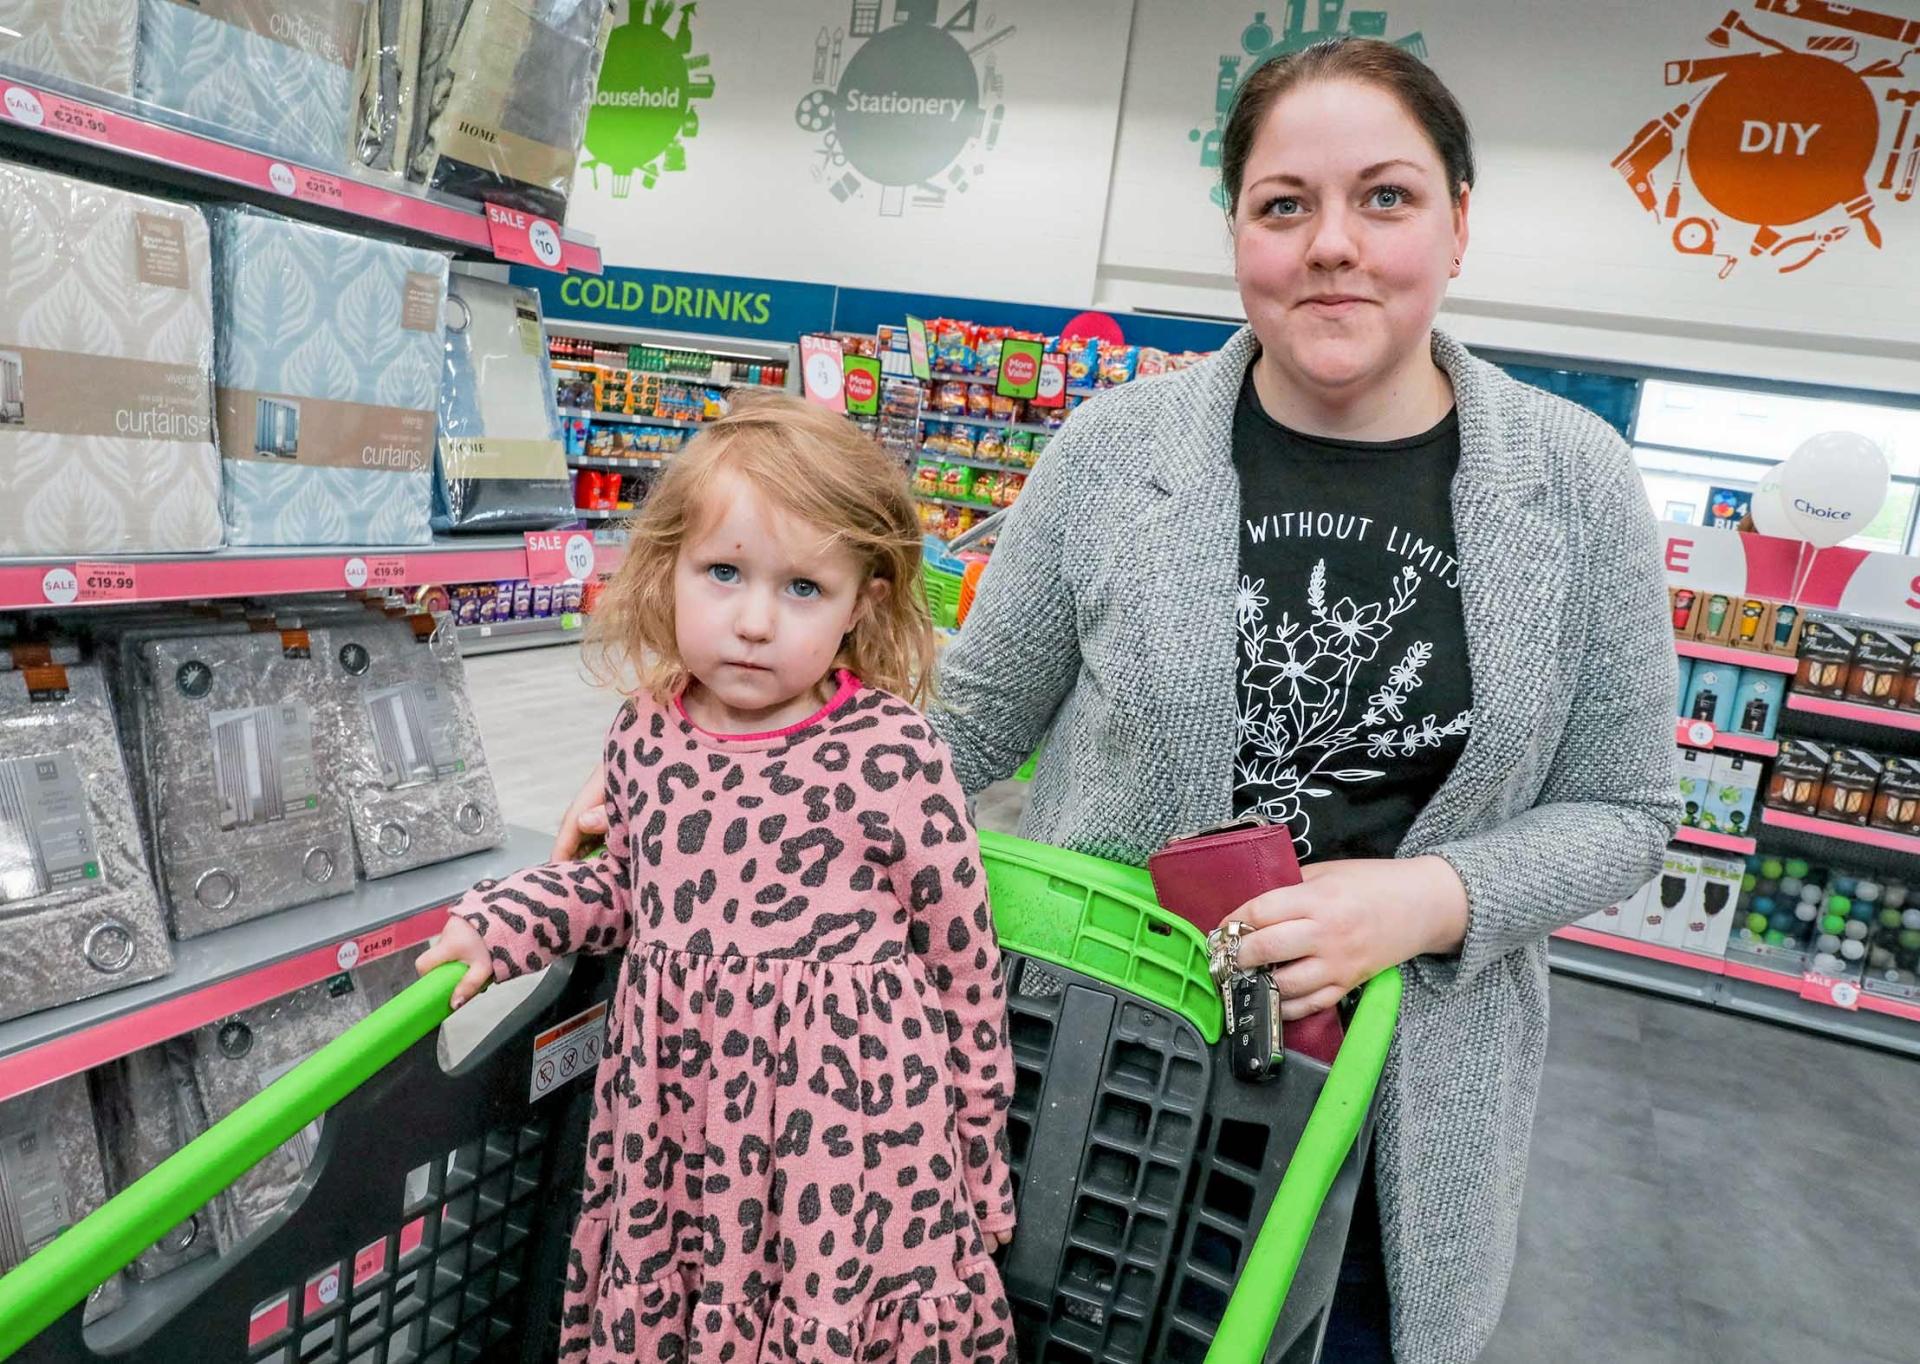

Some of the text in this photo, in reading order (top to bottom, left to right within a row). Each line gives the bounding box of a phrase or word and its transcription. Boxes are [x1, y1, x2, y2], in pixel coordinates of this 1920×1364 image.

[592, 86, 679, 108] ousehold
[846, 89, 965, 122] Stationery
[459, 121, 497, 144] HOME
[1740, 120, 1822, 155] DIY
[490, 207, 526, 230] SALE
[560, 276, 644, 312] COLD
[651, 284, 771, 325] DRINKS
[802, 337, 838, 352] SALE
[1008, 358, 1033, 370] More
[1043, 352, 1066, 364] ALE
[849, 373, 873, 386] More
[1008, 367, 1033, 379] Value
[116, 407, 200, 436] curtains
[362, 444, 421, 468] curtains
[1794, 498, 1851, 520] Choice
[1246, 511, 1373, 544] WITHOUT
[529, 535, 562, 551] SALE
[374, 566, 405, 577] €19.99
[45, 580, 76, 591] SALE
[87, 577, 134, 589] €19.99
[1803, 973, 1831, 987] SALE
